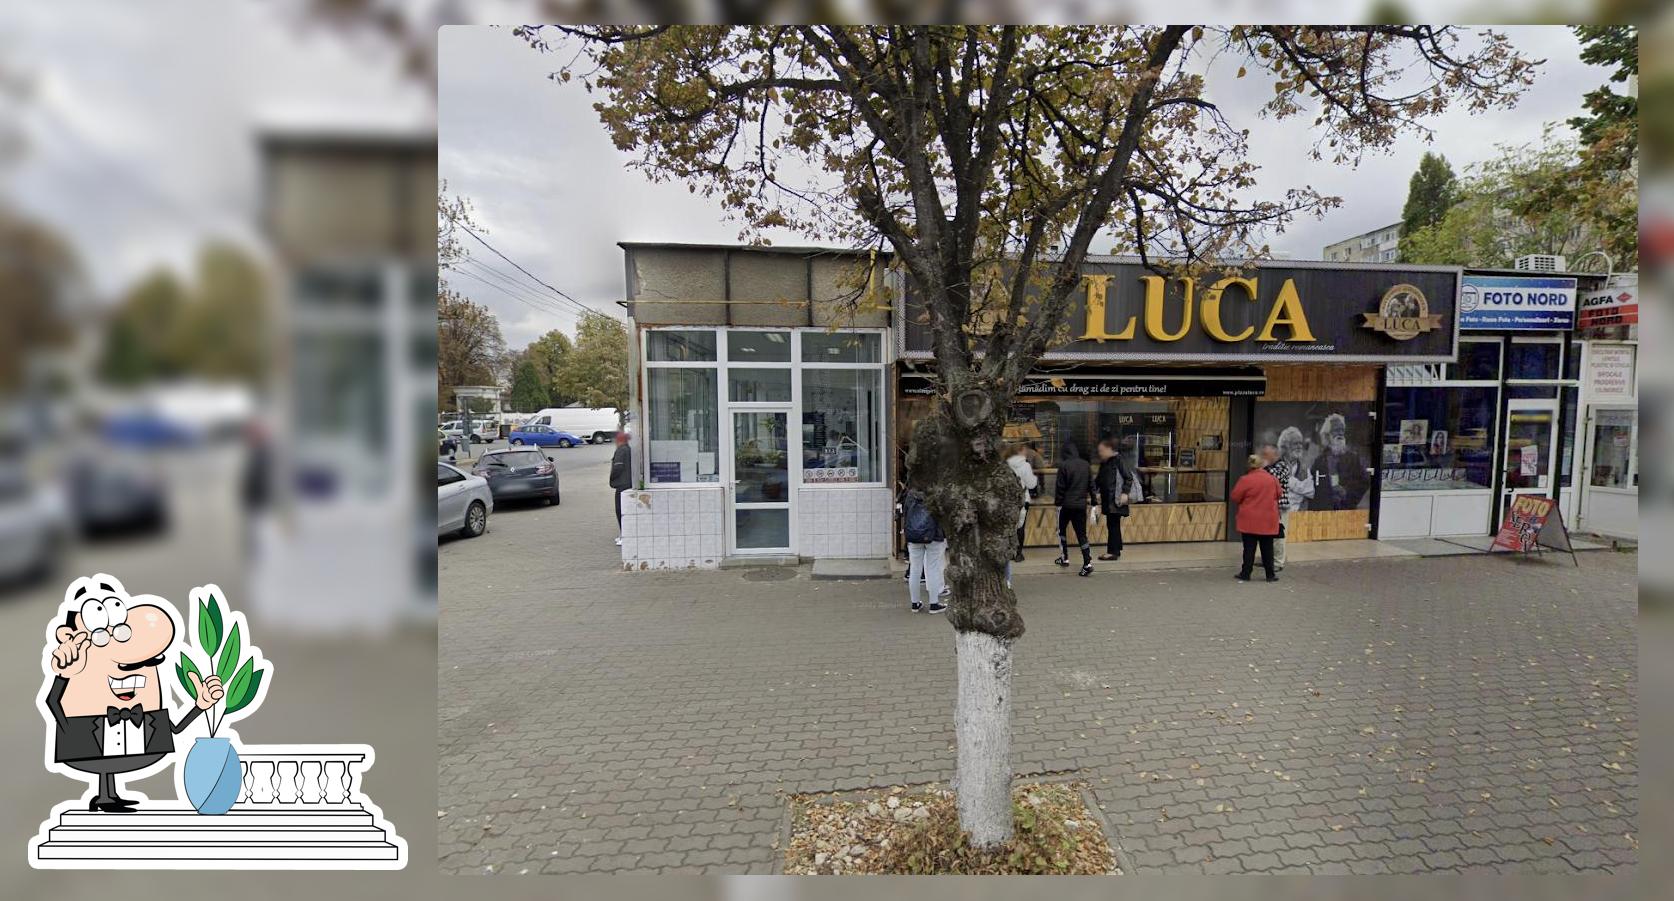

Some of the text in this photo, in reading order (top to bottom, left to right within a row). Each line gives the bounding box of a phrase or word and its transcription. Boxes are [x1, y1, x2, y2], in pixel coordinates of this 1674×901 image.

[1483, 292, 1568, 306] FOTO NORD
[1583, 295, 1614, 307] AGFA
[1077, 274, 1317, 342] LUCA
[1589, 307, 1619, 317] FOTO
[1384, 319, 1421, 330] LUCA
[1591, 315, 1622, 326] NORD
[1057, 385, 1068, 393] cu
[1069, 383, 1089, 395] drag
[1090, 384, 1099, 393] zi
[1100, 383, 1110, 393] de
[1111, 384, 1119, 393] zi
[1120, 384, 1148, 395] pentru
[1148, 384, 1167, 393] tine!
[1118, 415, 1134, 424] LUCA
[1151, 415, 1167, 423] LUCA
[1513, 496, 1551, 517] FOTO
